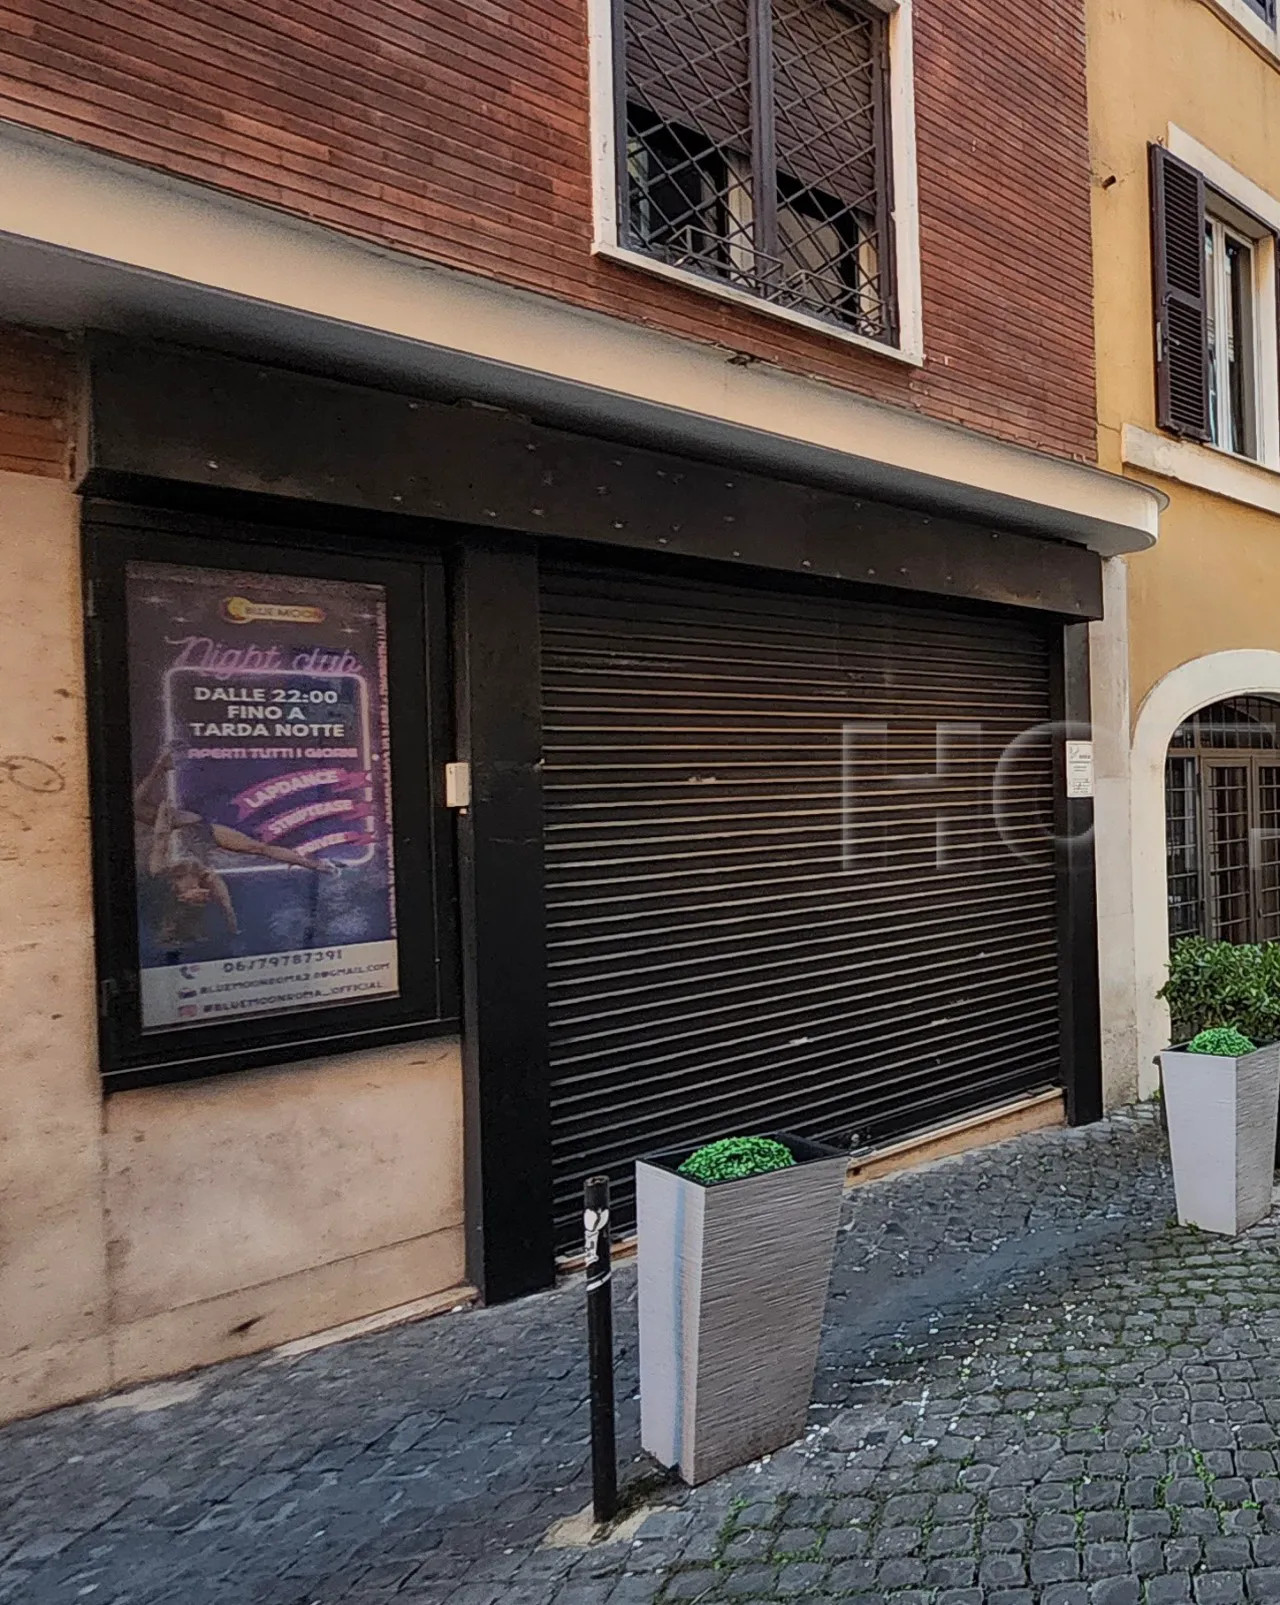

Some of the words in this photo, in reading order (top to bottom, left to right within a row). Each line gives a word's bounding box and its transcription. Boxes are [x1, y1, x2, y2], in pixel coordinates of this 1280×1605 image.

[163, 636, 281, 680] Night
[292, 648, 364, 674] club
[194, 686, 266, 702] DALLE
[271, 688, 338, 704] 22:00
[227, 705, 283, 720] FINO
[286, 706, 306, 720] A
[189, 722, 271, 737] TARDA
[274, 723, 345, 738] NOTTE
[187, 747, 247, 759] APERTI
[249, 747, 293, 759] TUTTI
[304, 747, 358, 758] GIORNI
[243, 769, 339, 809] LAPDANCE
[268, 799, 354, 836] STRIPTEASE
